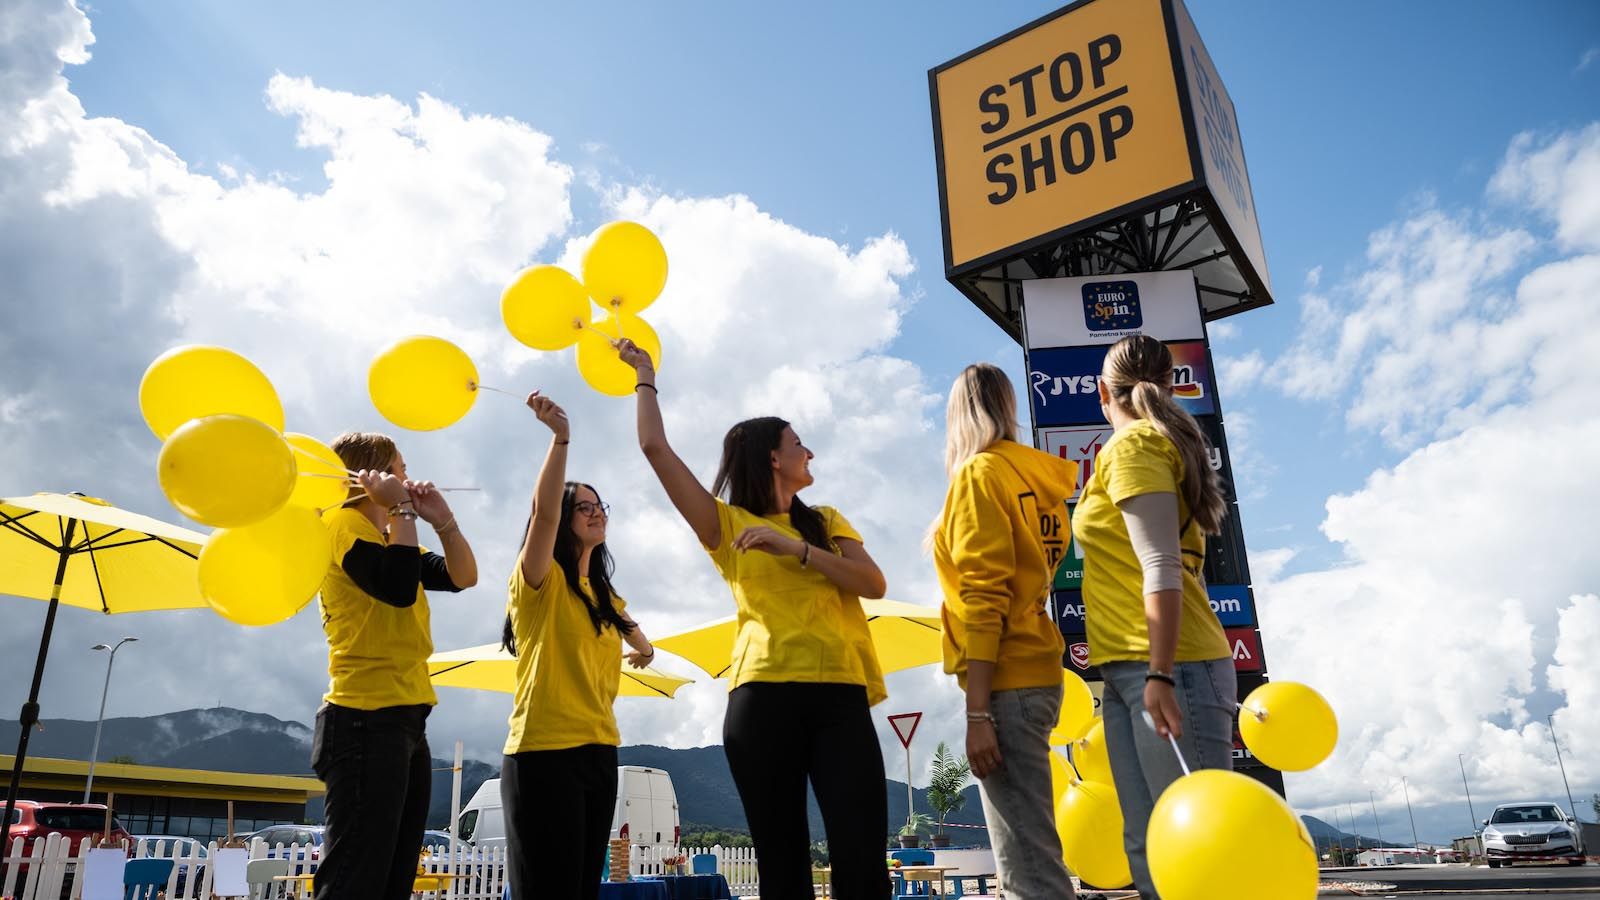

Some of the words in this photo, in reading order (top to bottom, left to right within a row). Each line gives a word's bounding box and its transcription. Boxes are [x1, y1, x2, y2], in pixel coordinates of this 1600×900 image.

[978, 33, 1122, 134] STOP
[985, 104, 1134, 206] SHOP
[1097, 292, 1126, 303] EURO
[1094, 302, 1130, 320] Spin
[1050, 375, 1102, 395] JYS
[1040, 513, 1062, 537] OP
[1062, 603, 1086, 617] AD
[1208, 598, 1241, 613] om
